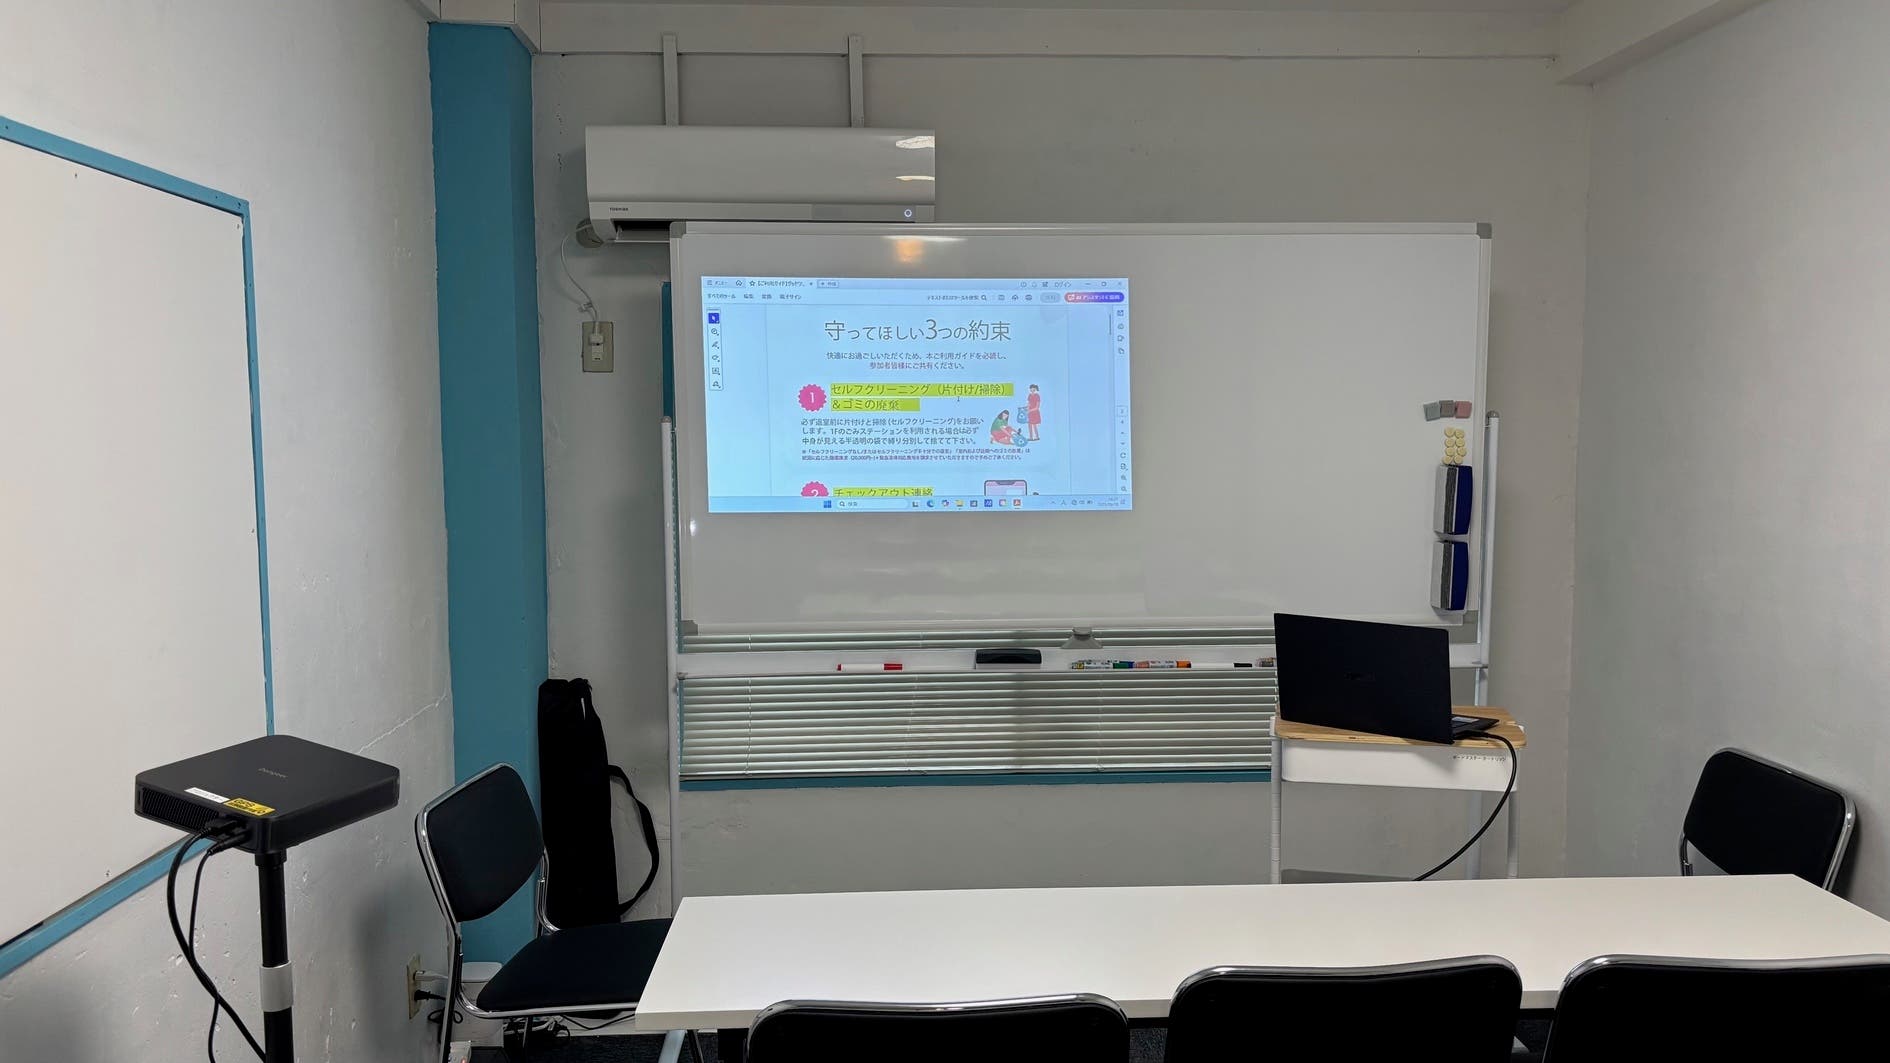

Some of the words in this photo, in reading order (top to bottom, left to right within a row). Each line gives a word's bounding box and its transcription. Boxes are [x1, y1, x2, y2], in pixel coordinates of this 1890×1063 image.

[824, 319, 1012, 342] 守ってほしい3つの約束
[826, 352, 1008, 361] 快適にお過ごしいただくため、本ご利用ガイドを必読し、
[869, 361, 966, 370] 参加者皆様にご共有ください。
[832, 383, 1006, 396] セルフクリーニング（片付け/掃除）
[809, 391, 815, 404] 1
[802, 427, 978, 436] します。1Fのごみステーションを利用される場合は必ず
[802, 436, 977, 446] 中身が見える半透明の袋で縛り分別して捨てて下さい。
